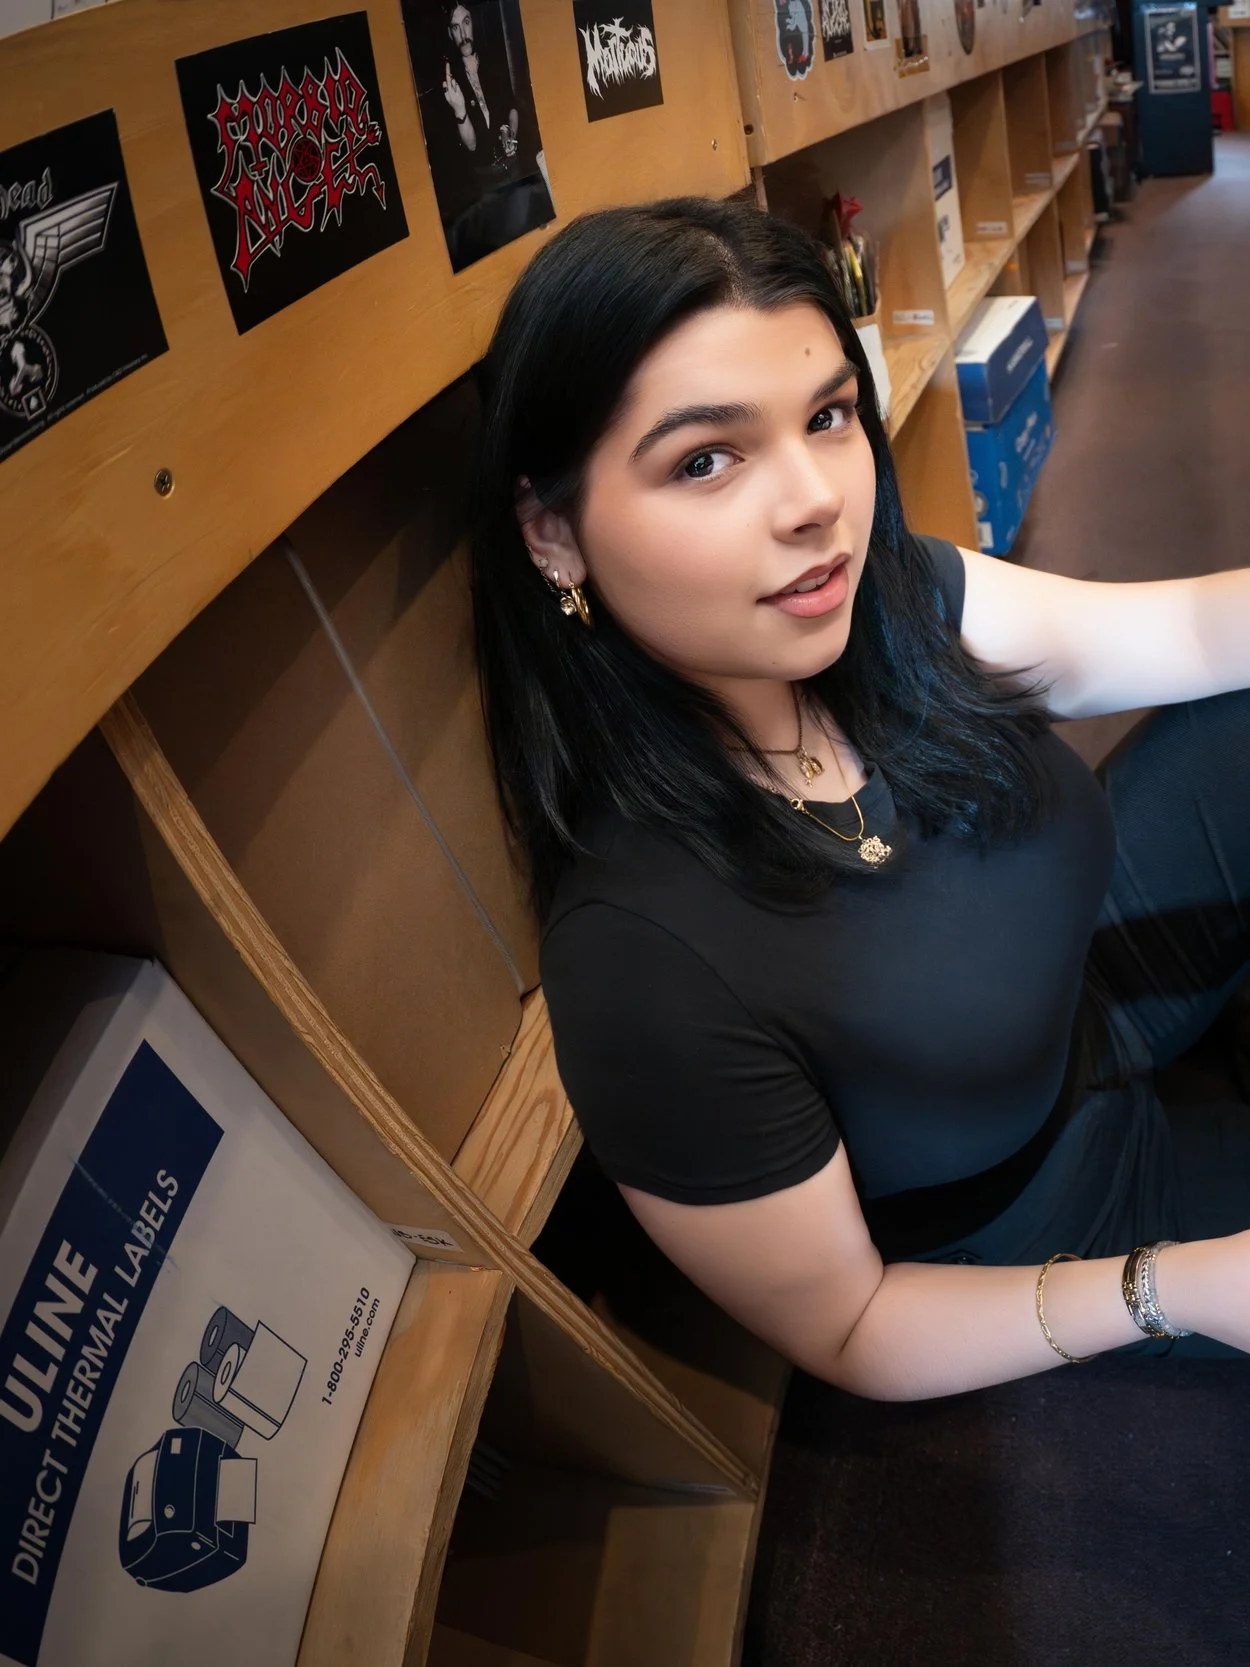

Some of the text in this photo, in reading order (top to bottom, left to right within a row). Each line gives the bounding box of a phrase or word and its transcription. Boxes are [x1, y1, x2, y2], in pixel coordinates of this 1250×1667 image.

[207, 47, 369, 185] MORBID
[0, 1239, 99, 1434] ULINE
[11, 1168, 180, 1586] DIRECT THERMAL LABELS
[321, 1286, 370, 1406] 1-800-295-5510
[355, 1298, 380, 1358] uline.com
